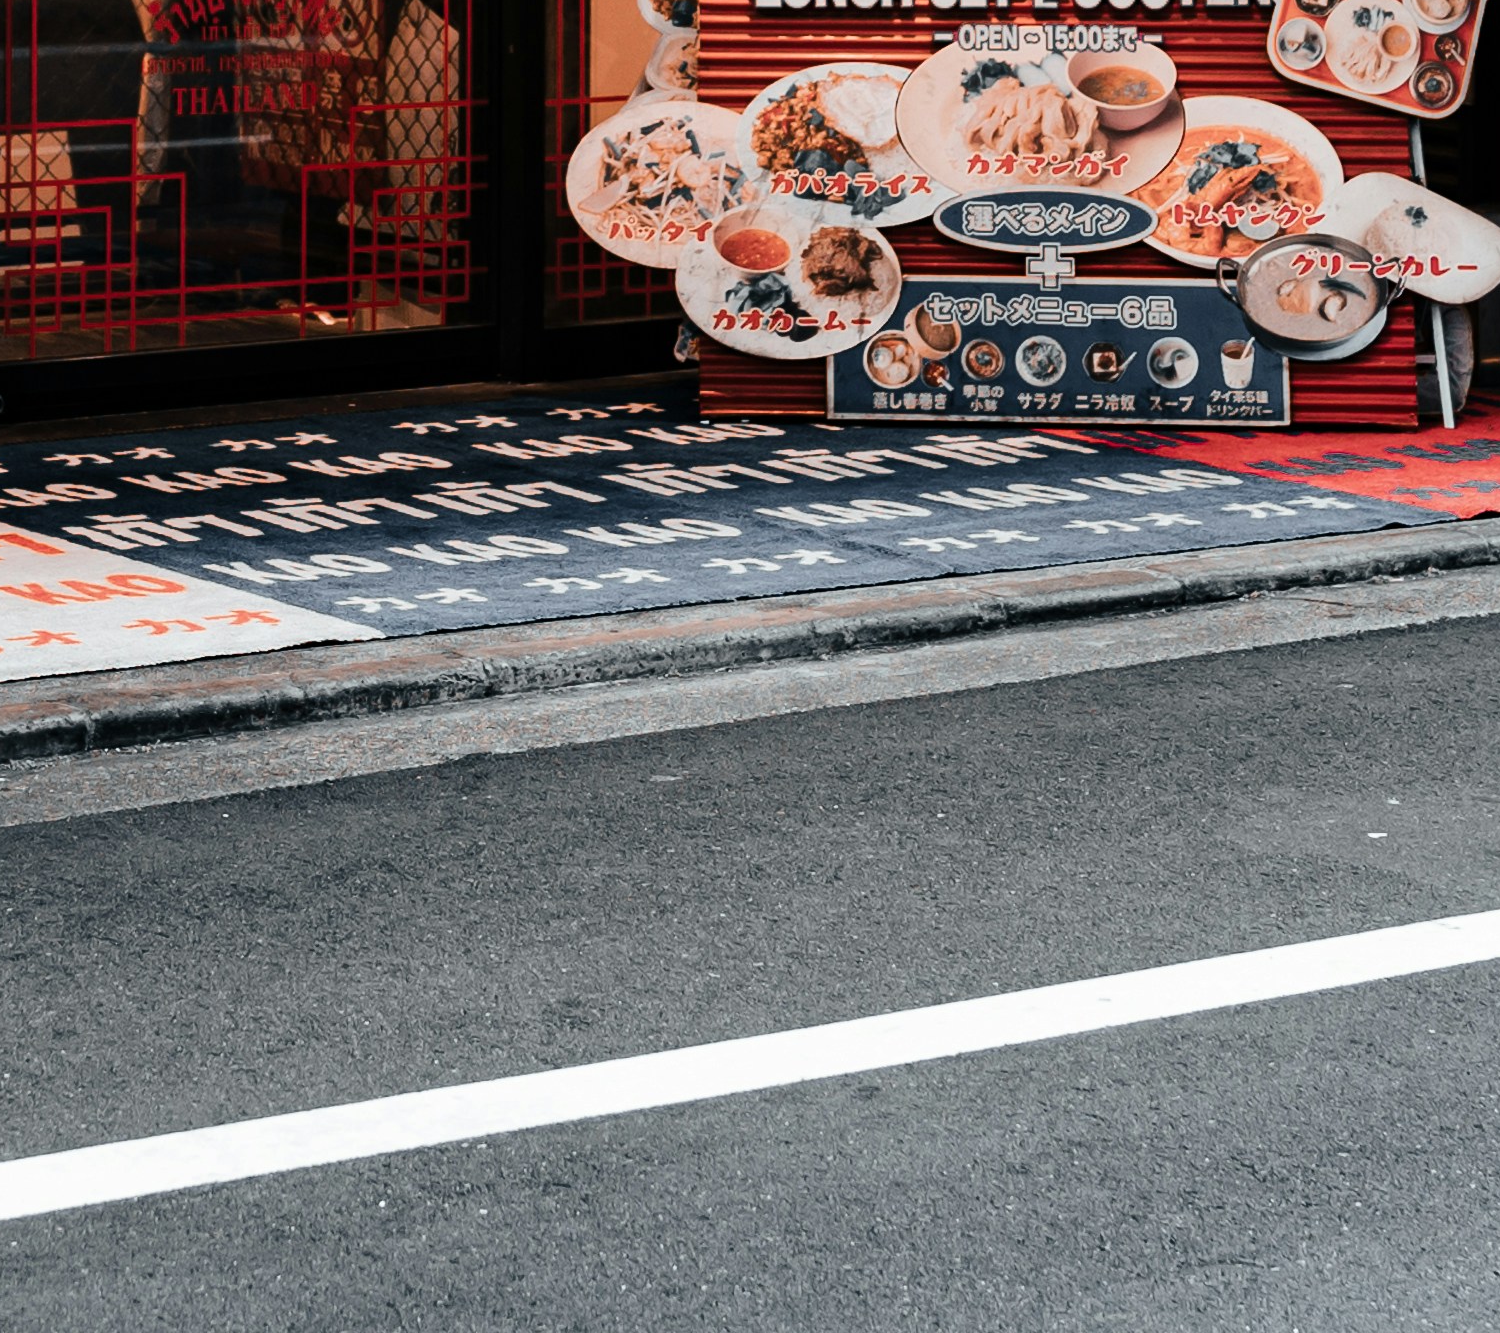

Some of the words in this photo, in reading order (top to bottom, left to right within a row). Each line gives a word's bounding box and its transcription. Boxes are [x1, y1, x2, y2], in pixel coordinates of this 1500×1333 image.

[958, 25, 1018, 51] OPEN
[172, 83, 318, 116] THAILAND
[966, 154, 1131, 177] カオマンガイ
[770, 171, 933, 197] ガパオライス
[963, 203, 1128, 236] 選べるメイン
[1172, 203, 1326, 228] トムヤンクン
[608, 220, 714, 244] パッタイ
[1290, 253, 1479, 278] グリーンカレー
[712, 310, 873, 332] カオカームー
[927, 293, 1178, 330] セットメニュー6品
[1017, 393, 1063, 410] サラダ
[1150, 395, 1195, 412] スープ
[120, 466, 286, 494] KAO
[286, 452, 453, 477] KAO
[470, 435, 633, 460] KAO
[625, 423, 786, 445] KAO
[203, 553, 391, 585] KAO
[386, 535, 569, 565] KAO
[563, 518, 742, 548] KAO
[753, 499, 932, 527] KAO
[918, 483, 1091, 510] KAO
[1071, 469, 1243, 495] KAO
[335, 587, 488, 613] カオ
[523, 567, 671, 594] カオ
[702, 548, 846, 575] カオ
[899, 529, 1040, 552] カオ
[1061, 512, 1202, 534] カオ
[1221, 495, 1356, 518] カオ
[122, 609, 281, 636] カオ
